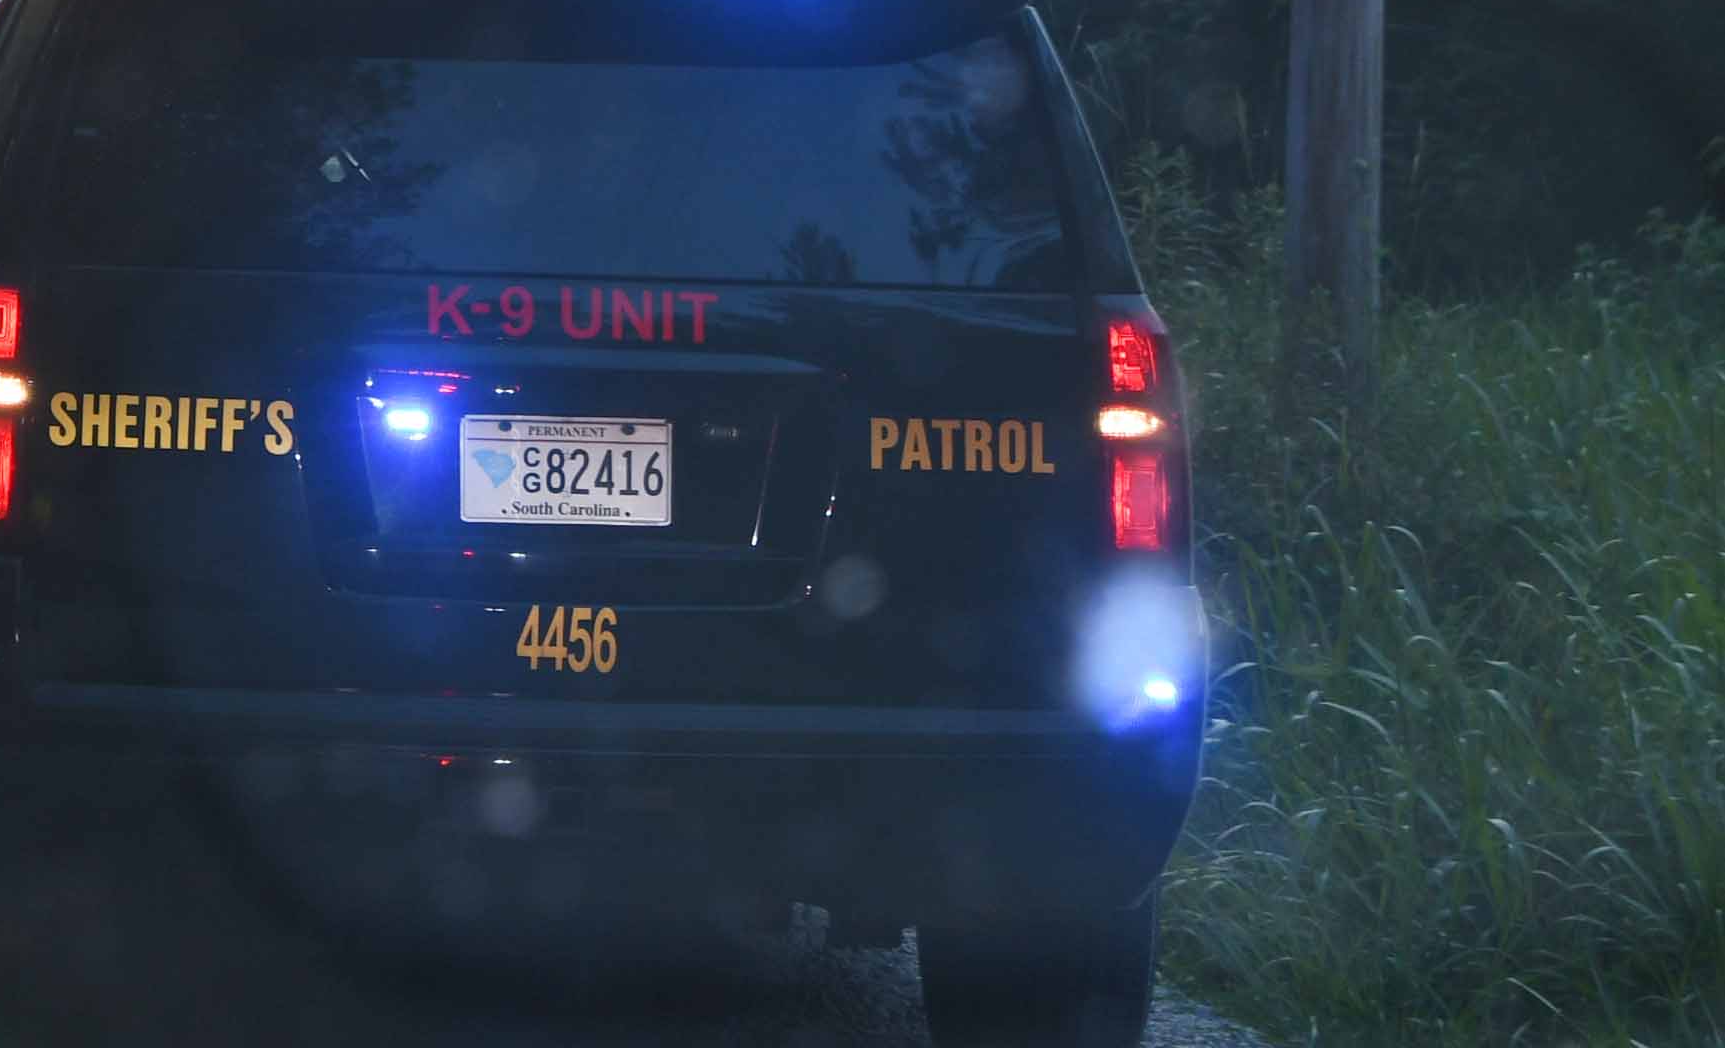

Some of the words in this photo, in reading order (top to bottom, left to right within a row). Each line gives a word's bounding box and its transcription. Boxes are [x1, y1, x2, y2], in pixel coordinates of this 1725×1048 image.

[427, 284, 535, 337] K-9
[560, 286, 719, 344] UNIT
[48, 391, 294, 456] SHERIFF'S
[527, 425, 608, 438] PERMANENT
[869, 417, 1056, 474] PATROL
[546, 448, 664, 497] 82416
[510, 500, 554, 517] South
[557, 501, 621, 518] Carolina
[516, 604, 618, 673] 4456
